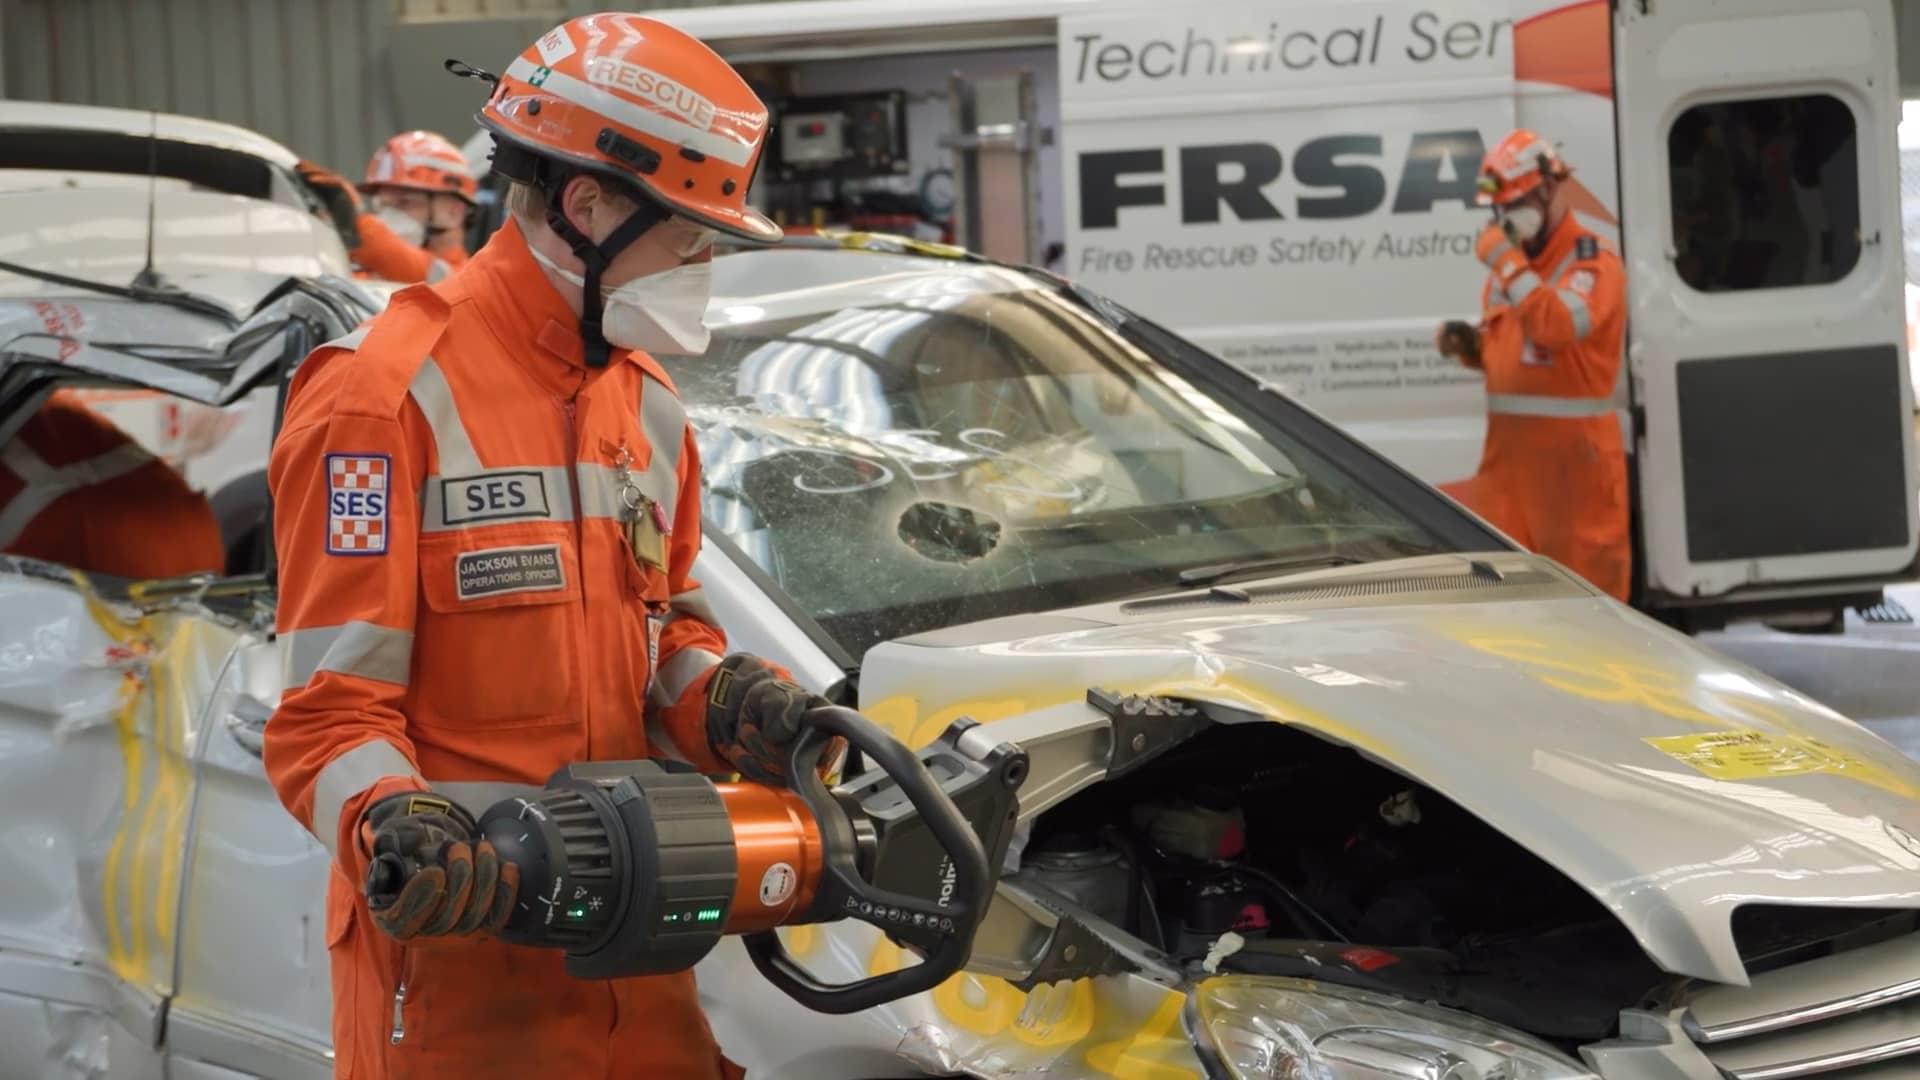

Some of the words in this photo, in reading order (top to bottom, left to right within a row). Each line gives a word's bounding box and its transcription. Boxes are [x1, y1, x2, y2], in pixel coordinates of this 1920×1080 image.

[1073, 17, 1383, 83] Technical
[594, 59, 713, 127] RESCUE
[1078, 129, 1485, 230] FRSA
[1081, 246, 1134, 273] Fire
[1145, 241, 1257, 270] Rescue
[1268, 234, 1366, 265] Safety
[1373, 228, 1477, 258] Austra
[332, 492, 383, 516] SES
[466, 481, 526, 512] SES
[461, 554, 517, 575] JACKSON
[521, 553, 554, 567] EVANS
[462, 571, 522, 589] OPERATIONS
[525, 569, 557, 580] OFFICER
